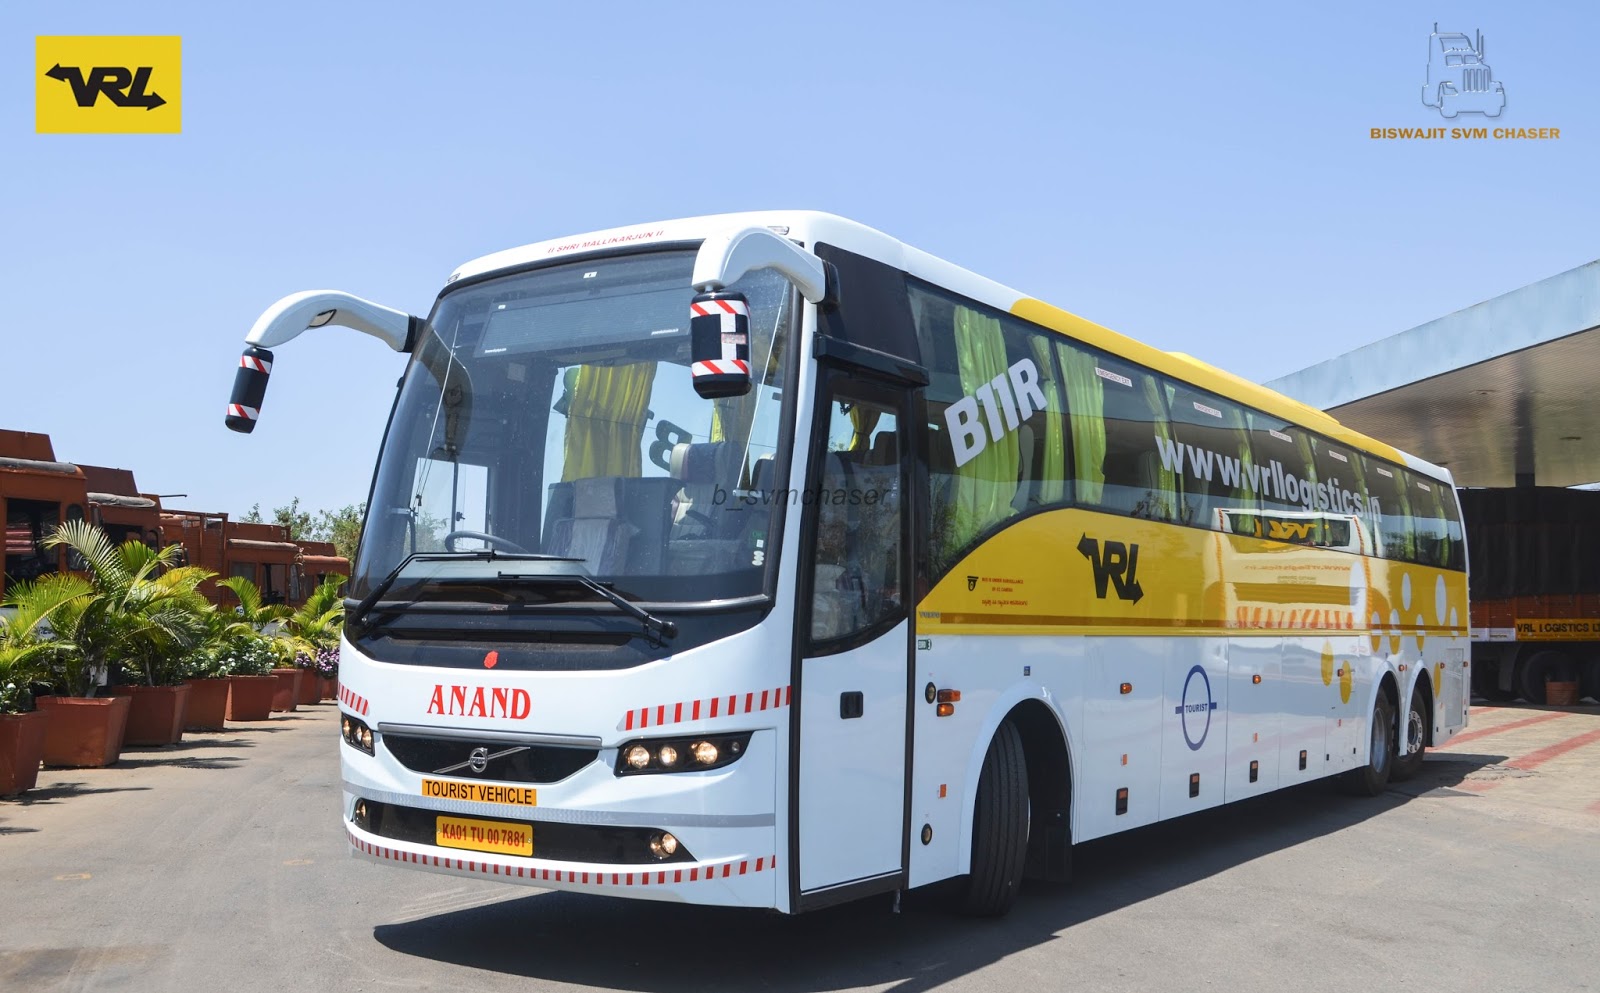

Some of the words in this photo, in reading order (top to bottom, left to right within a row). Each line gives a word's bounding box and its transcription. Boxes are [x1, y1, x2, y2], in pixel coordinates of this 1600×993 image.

[556, 243, 580, 253] SHRI
[581, 232, 654, 248] MALLIKARJUN
[1155, 436, 1382, 523] www.vrllogistics.in
[1077, 532, 1144, 606] VRL
[1517, 623, 1536, 632] VRL
[1539, 623, 1589, 632] LOGISTICS
[427, 684, 532, 720] ANAND
[1185, 703, 1208, 713] TOURIST
[425, 781, 475, 799] TOURIST
[478, 785, 533, 805] VEHICLE
[442, 823, 467, 841] KA01
[470, 826, 484, 843] TU
